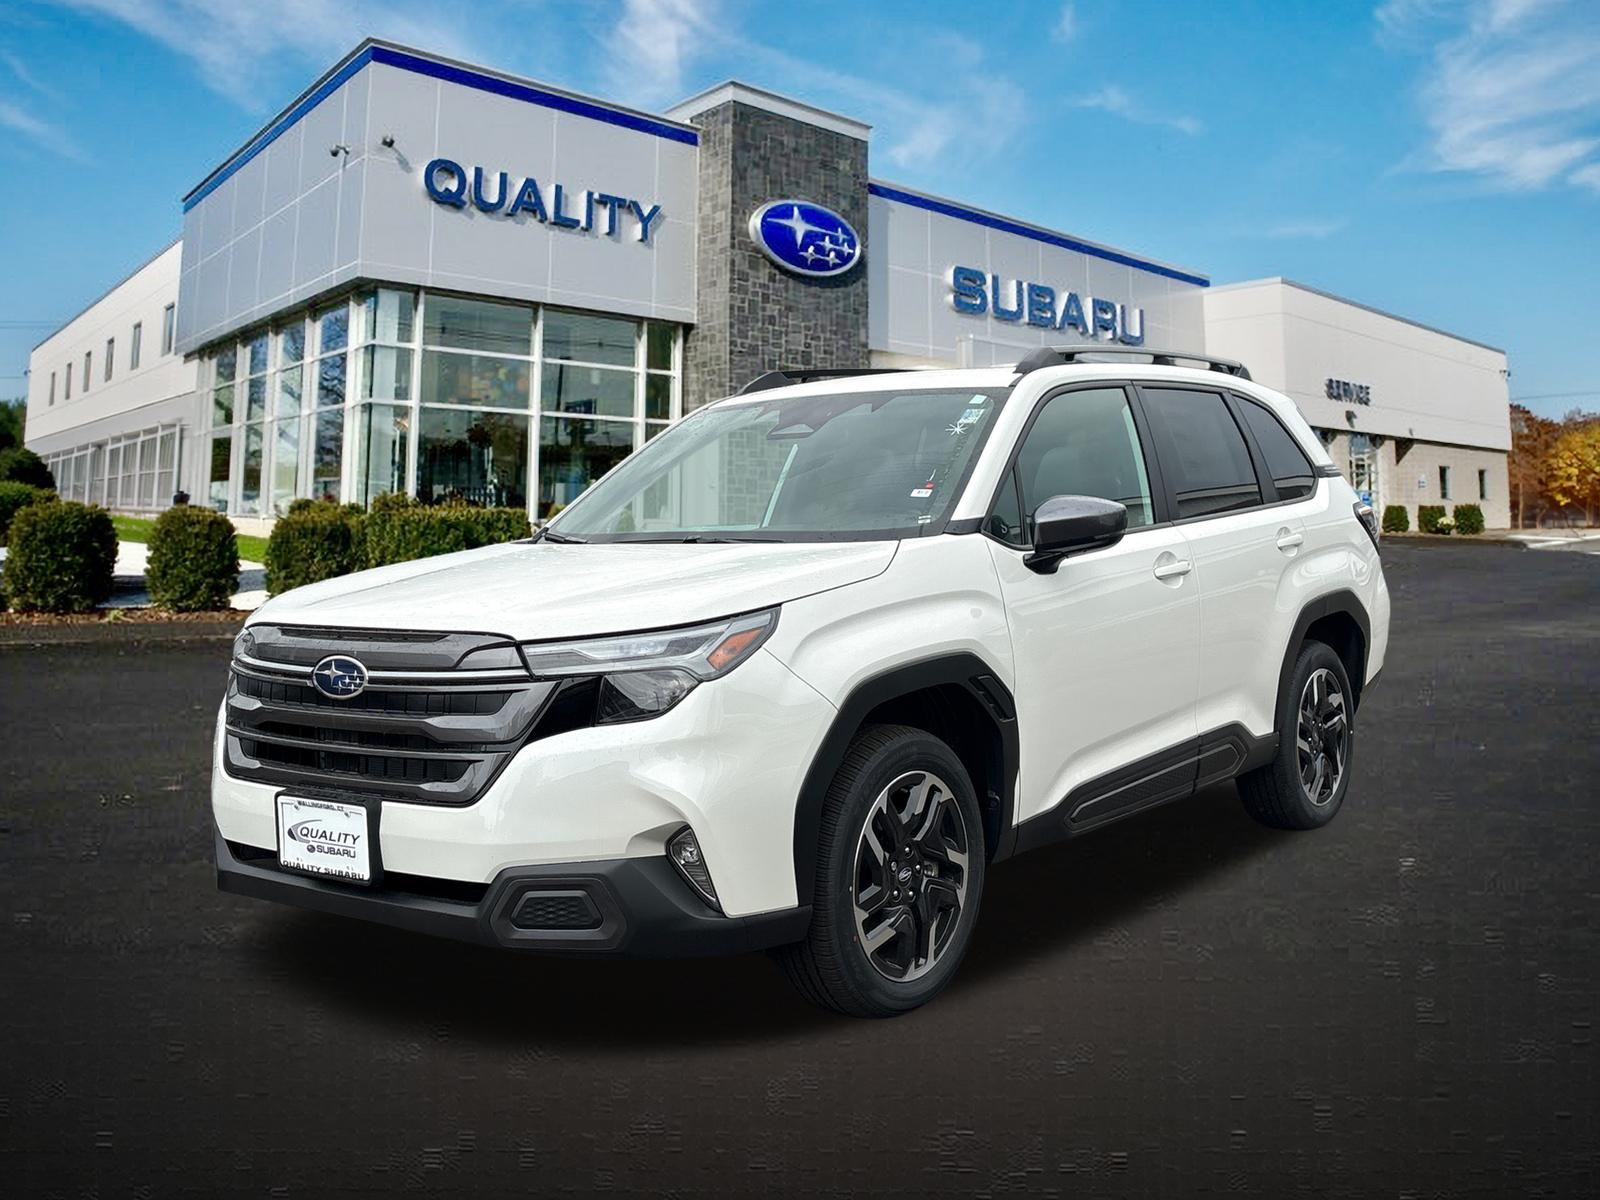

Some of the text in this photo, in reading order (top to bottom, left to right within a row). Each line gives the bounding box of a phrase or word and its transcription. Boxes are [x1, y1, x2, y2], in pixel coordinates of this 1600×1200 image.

[423, 157, 662, 243] QUALITY
[951, 265, 1145, 346] SUBARU
[1325, 378, 1371, 406] SERVICE
[300, 826, 360, 845] QUALITY
[316, 844, 356, 858] SUBARU
[282, 860, 365, 880] QUALITY SUBARU
